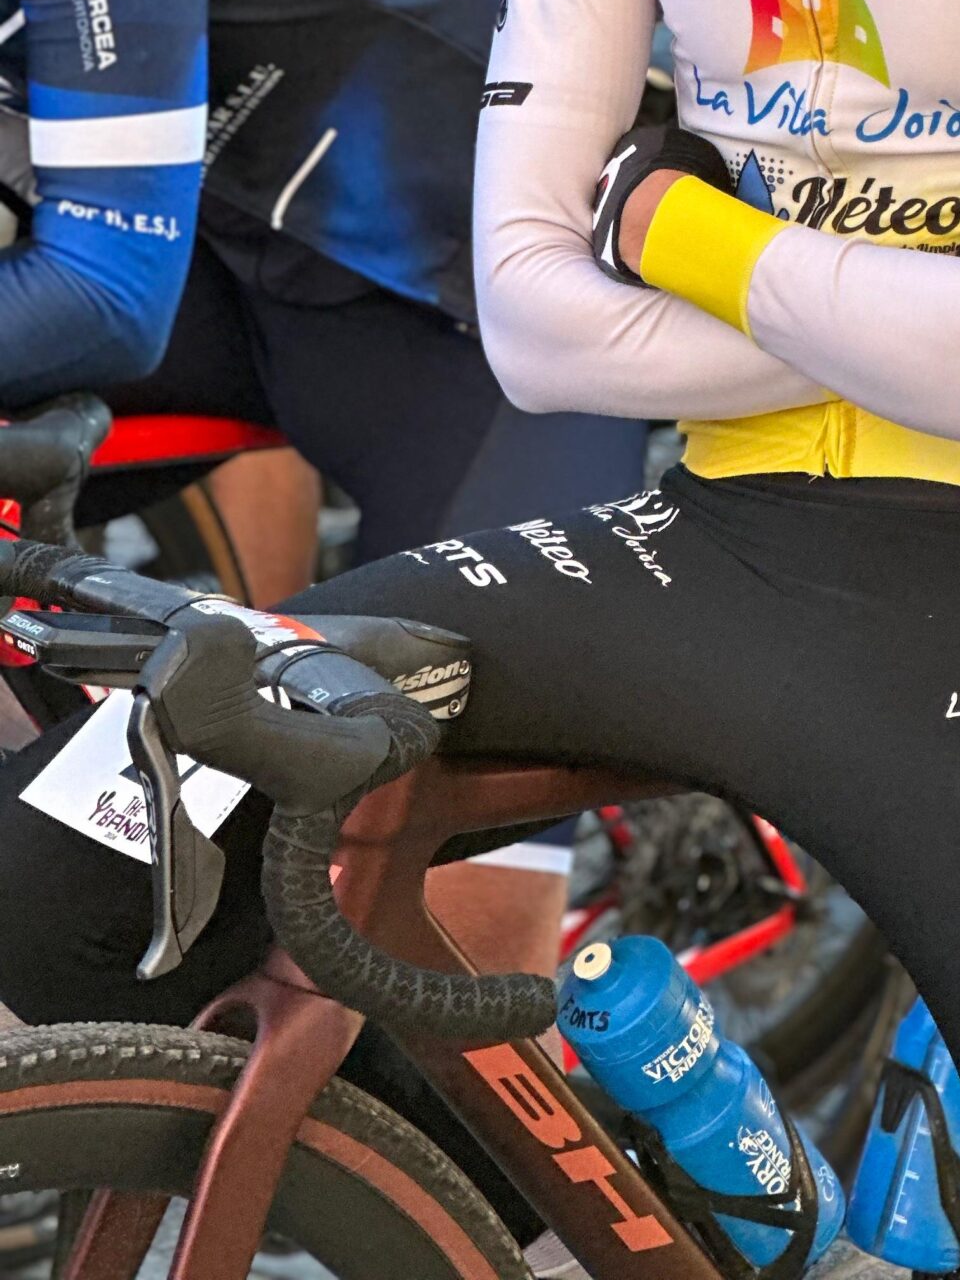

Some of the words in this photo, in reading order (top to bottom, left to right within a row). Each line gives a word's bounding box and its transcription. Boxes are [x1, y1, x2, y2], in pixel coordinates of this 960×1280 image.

[693, 64, 734, 116] La
[6, 613, 45, 636] SIGMA
[390, 660, 462, 691] ision
[462, 1041, 675, 1253] BH
